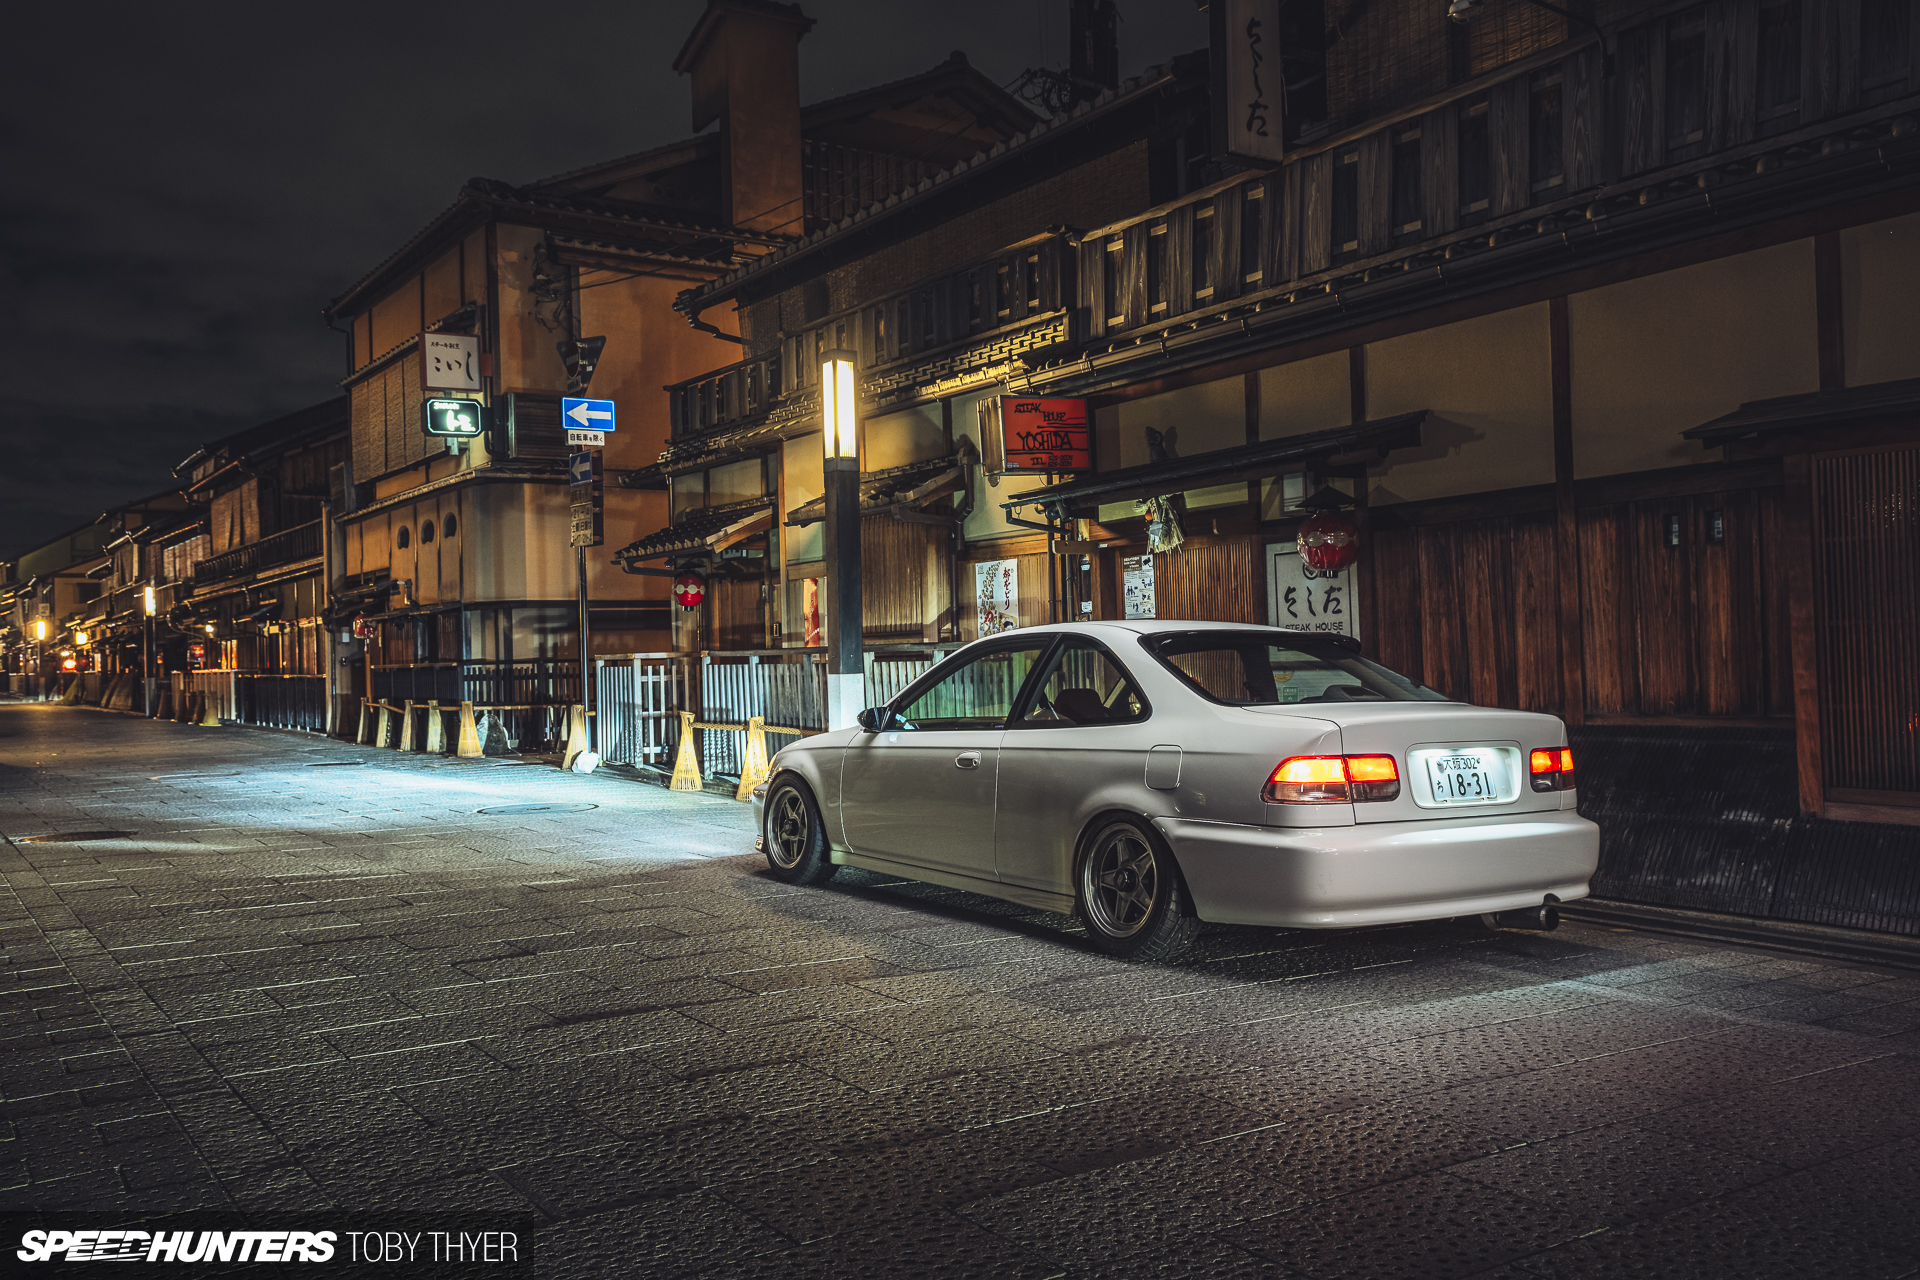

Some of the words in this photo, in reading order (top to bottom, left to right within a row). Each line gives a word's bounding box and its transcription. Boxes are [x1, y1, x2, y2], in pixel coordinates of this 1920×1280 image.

[434, 350, 474, 382] こいし
[1014, 402, 1042, 413] STEAK
[570, 433, 603, 442] 自転車を除く
[1016, 431, 1074, 451] YOSHIDA
[1315, 621, 1344, 631] HOUSE
[1447, 771, 1491, 797] 18-31
